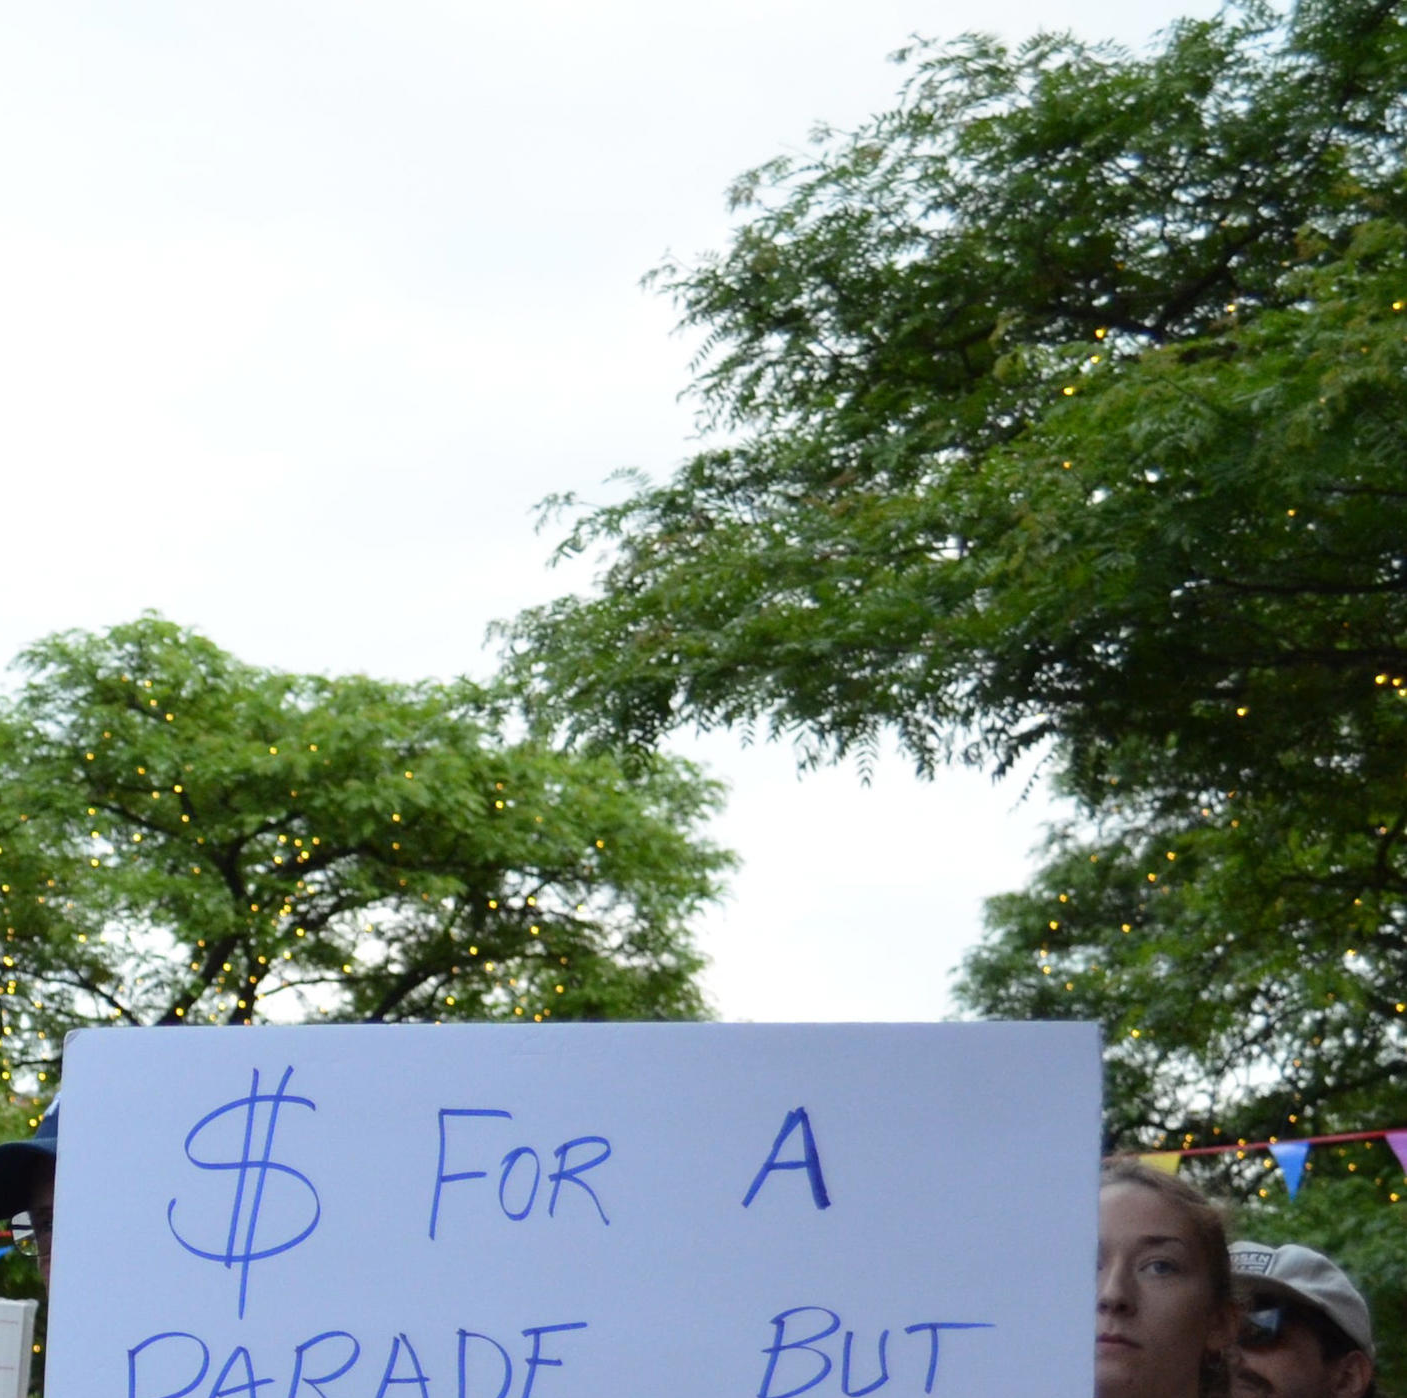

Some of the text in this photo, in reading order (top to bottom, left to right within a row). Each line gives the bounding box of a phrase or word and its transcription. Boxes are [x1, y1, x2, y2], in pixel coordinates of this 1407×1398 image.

[168, 1065, 830, 1319] $ FOR A
